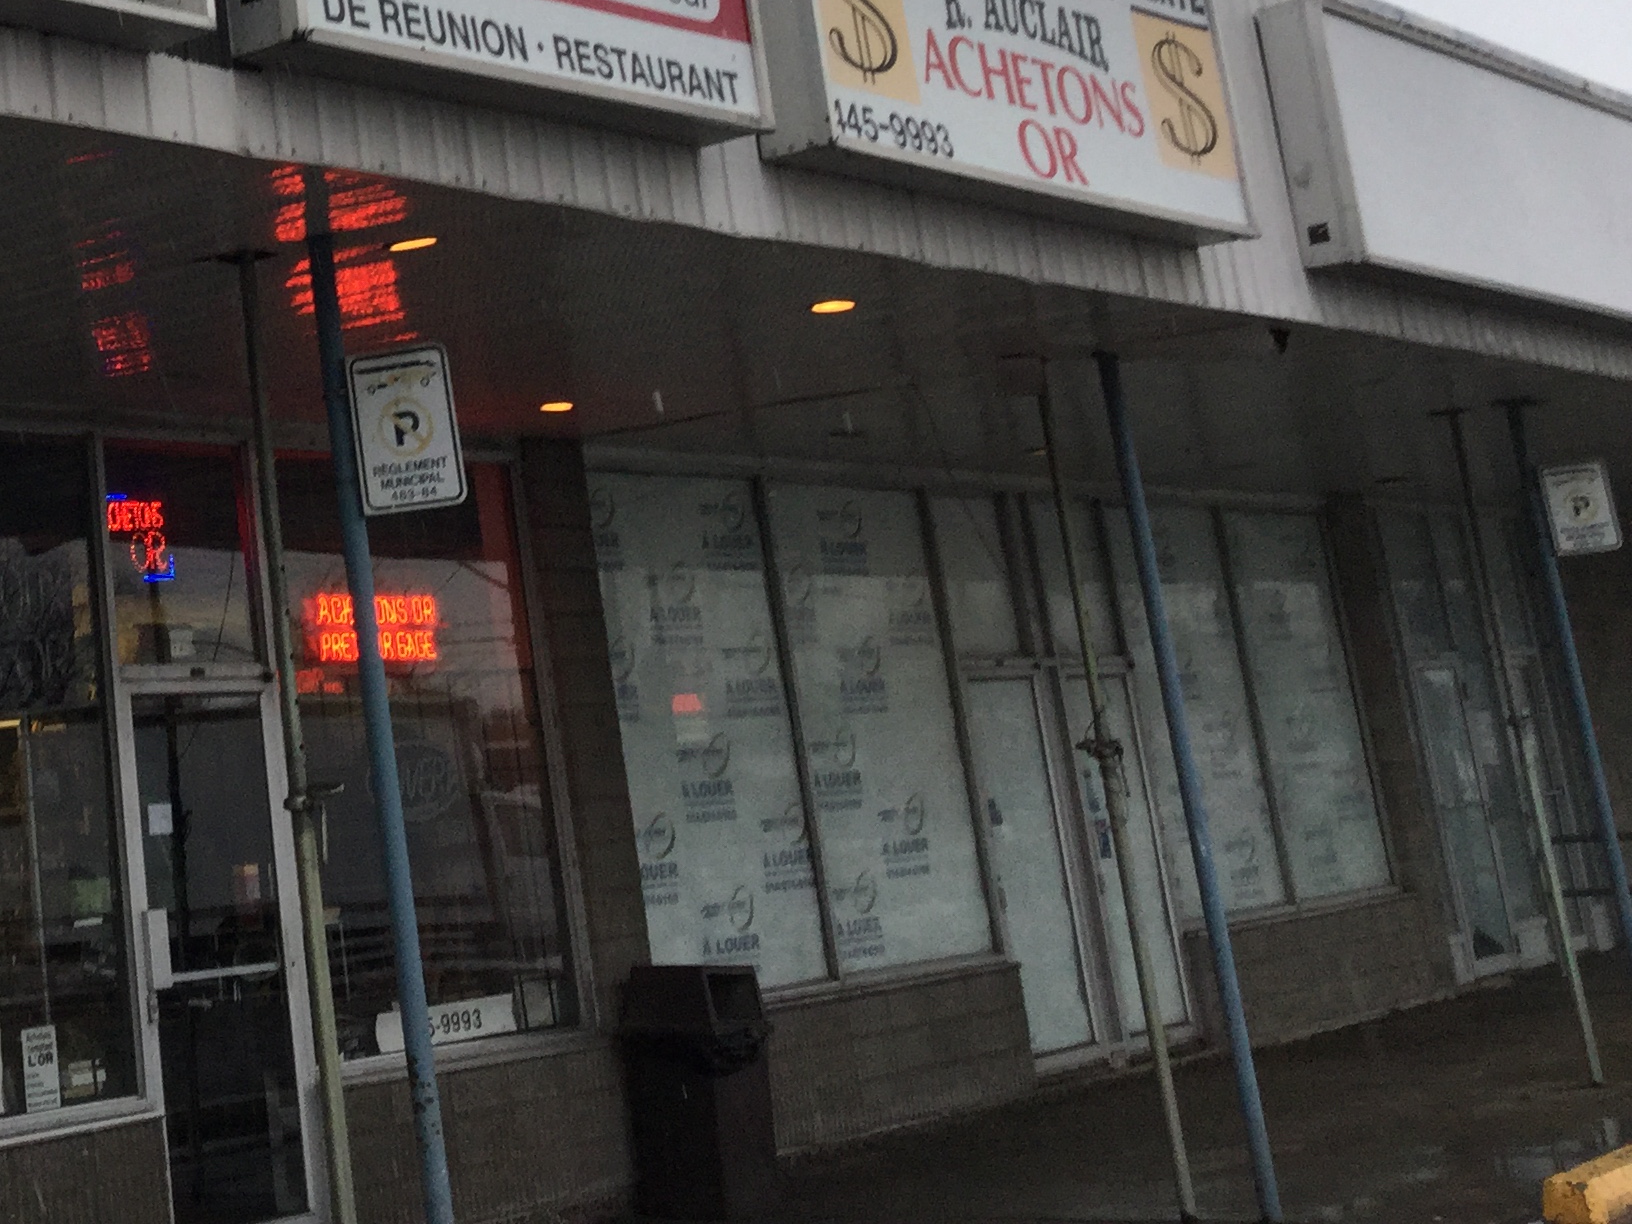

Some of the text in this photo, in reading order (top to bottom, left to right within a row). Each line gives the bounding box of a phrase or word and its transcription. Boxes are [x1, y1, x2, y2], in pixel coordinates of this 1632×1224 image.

[553, 35, 738, 105] RESTAURANT
[924, 28, 1145, 138] ACHETONS
[1018, 119, 1089, 186] OR
